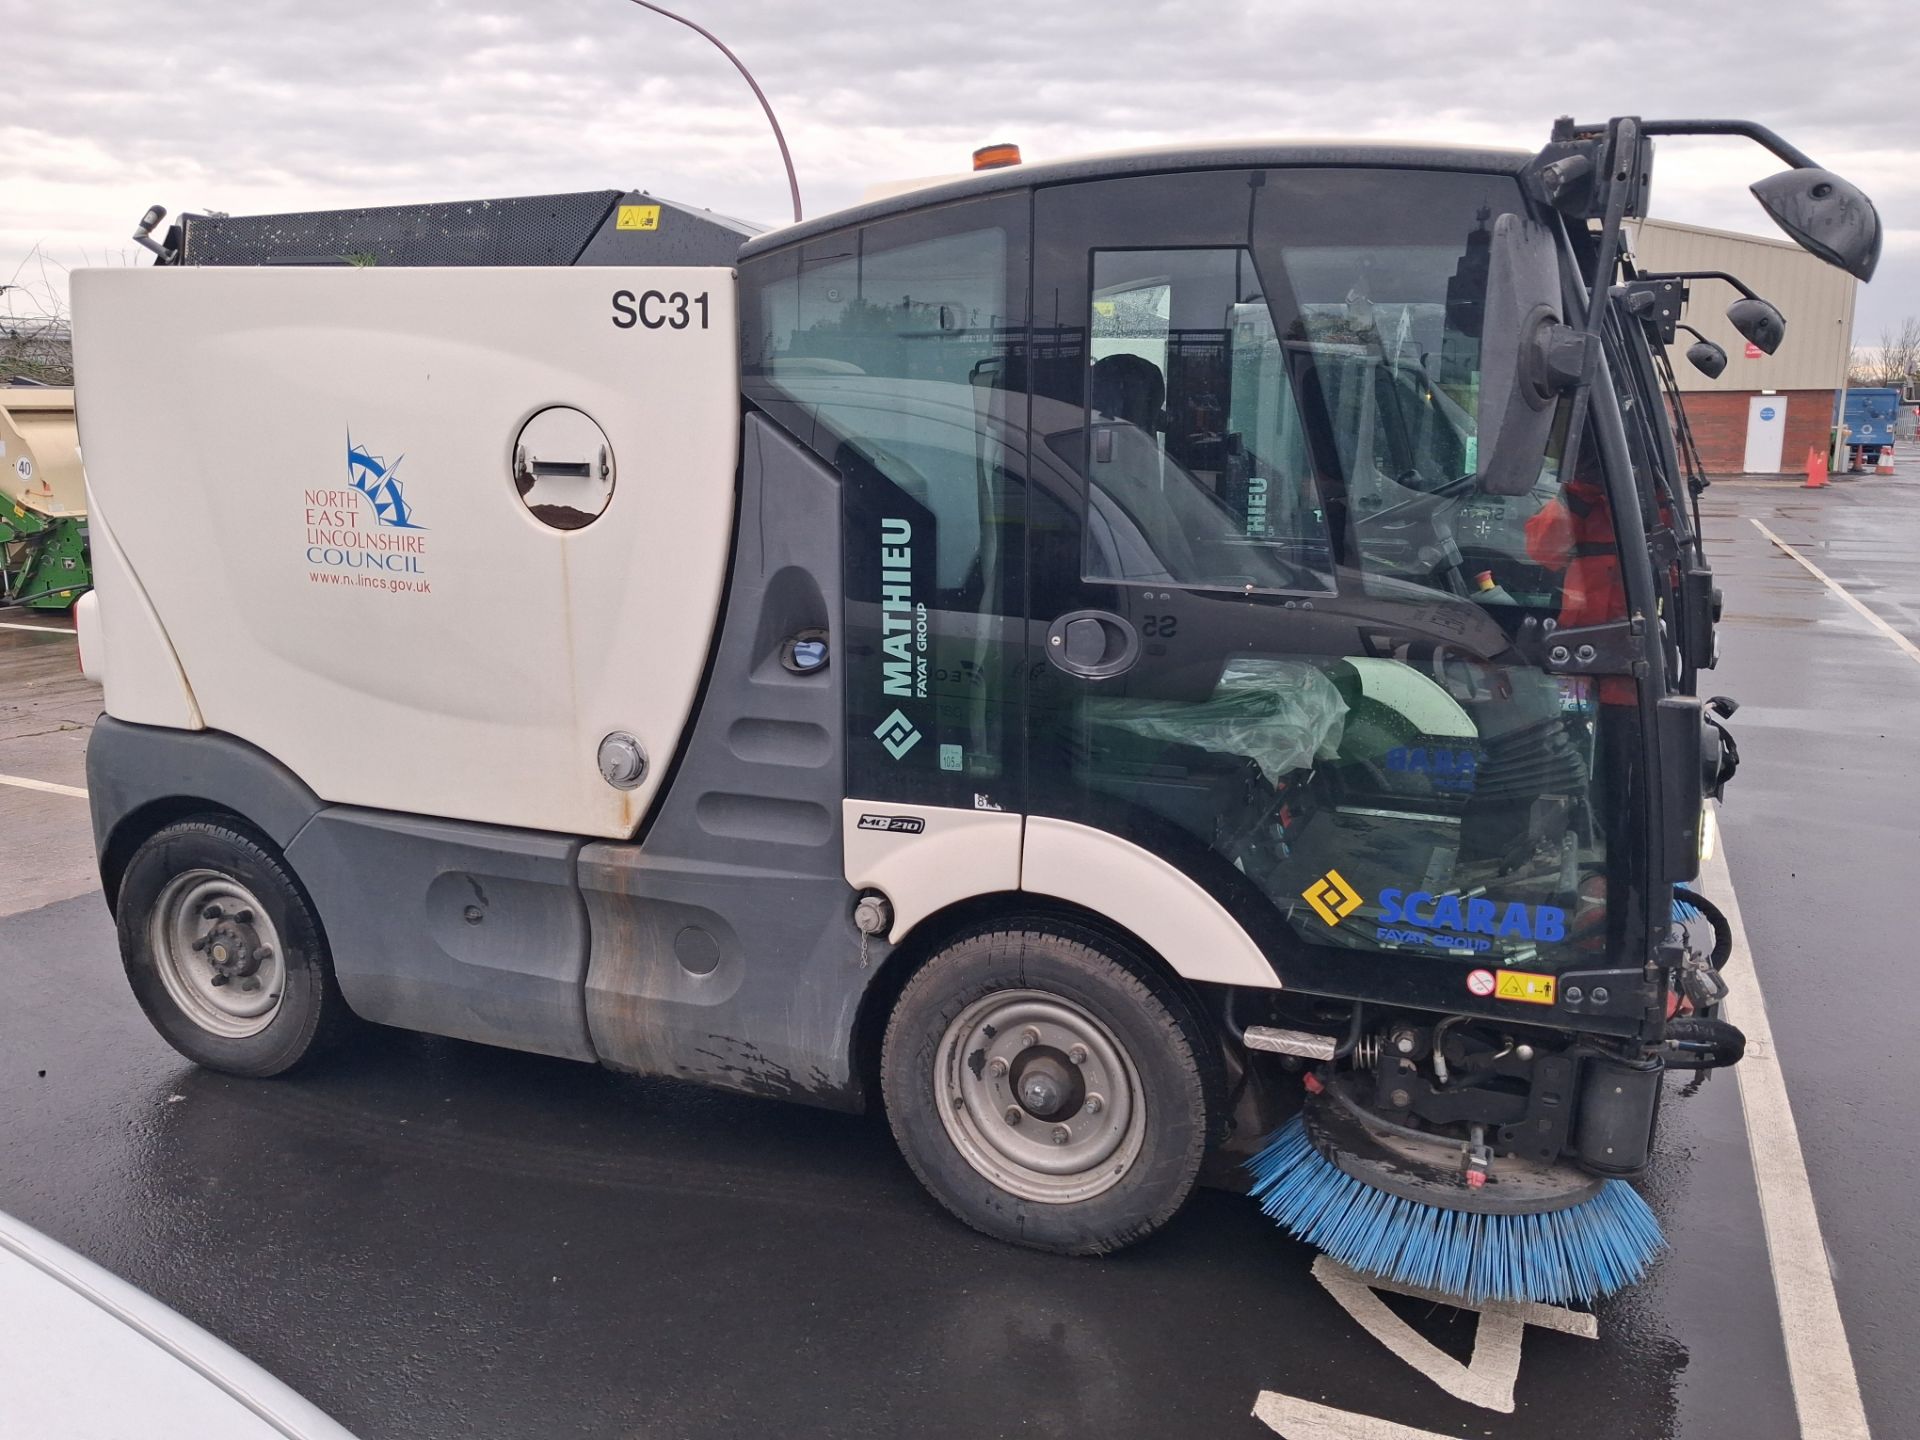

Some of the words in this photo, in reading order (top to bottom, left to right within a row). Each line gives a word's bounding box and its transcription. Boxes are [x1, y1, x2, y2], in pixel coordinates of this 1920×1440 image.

[611, 289, 709, 329] SC31
[19, 460, 30, 475] 40
[304, 488, 358, 509] NORTH
[305, 508, 359, 528] EAST
[307, 528, 425, 554] LINCOLNSHIRE
[306, 546, 425, 574] COUNCIL
[881, 517, 912, 698] MATHIEU
[916, 602, 928, 652] GROUP
[916, 655, 928, 698] FAYAT
[861, 818, 887, 828] MC
[890, 821, 918, 830] 210
[1377, 887, 1566, 942] SCARAB
[1375, 928, 1427, 944] FAYAT
